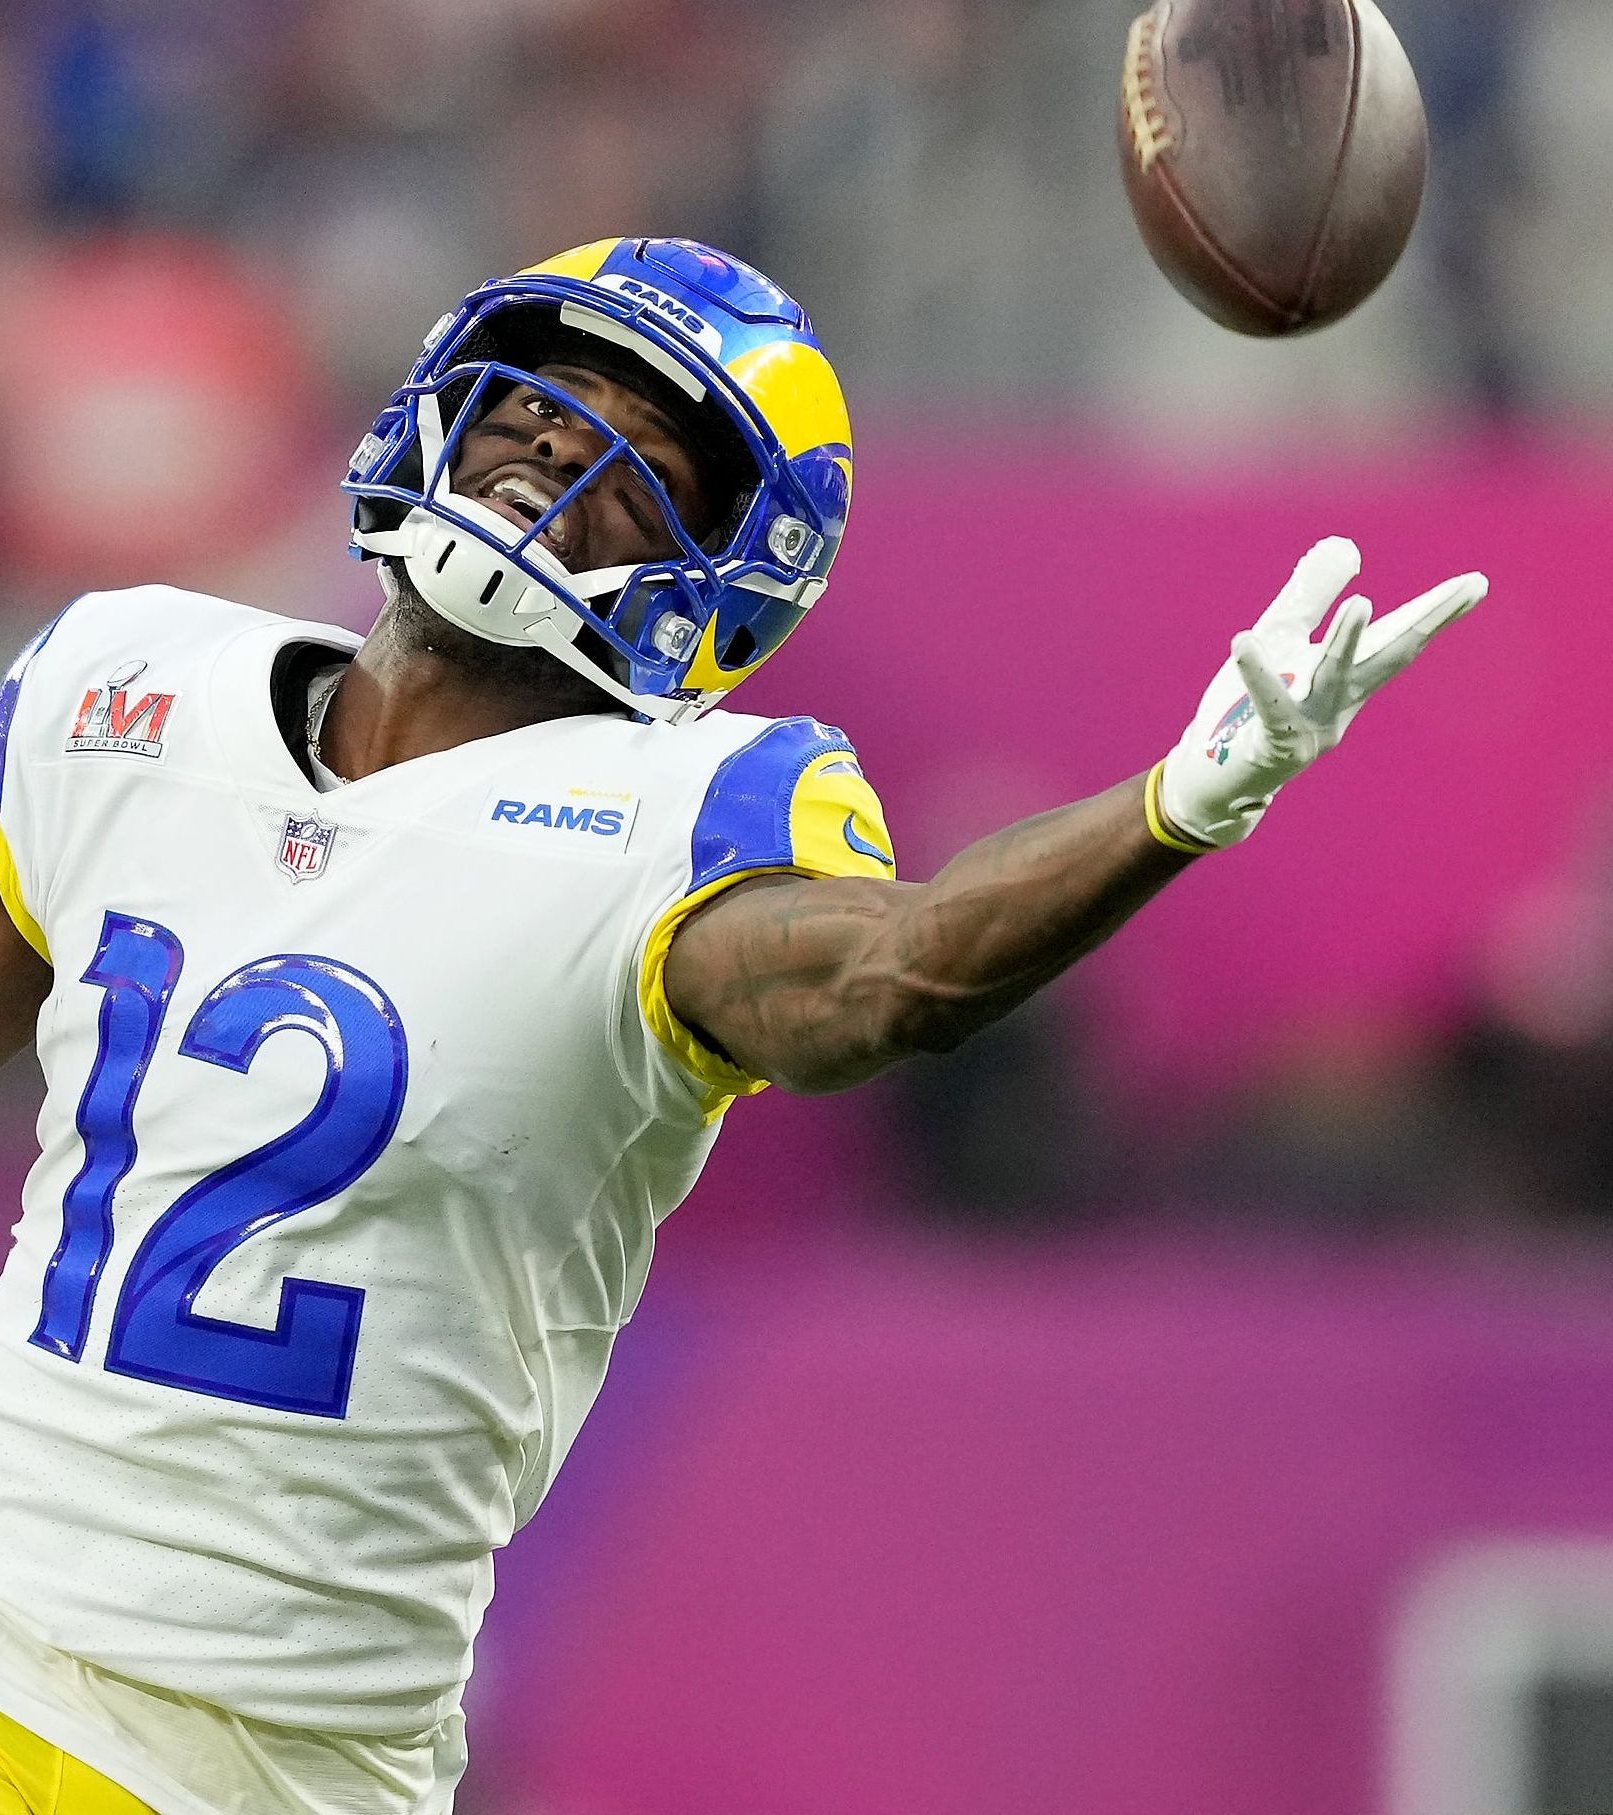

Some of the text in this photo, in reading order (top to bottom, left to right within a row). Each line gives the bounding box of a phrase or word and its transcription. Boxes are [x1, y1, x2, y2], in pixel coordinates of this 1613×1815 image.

[619, 280, 705, 334] RAMS
[72, 739, 149, 752] SUPER BOWL
[491, 799, 625, 836] RAMS
[282, 839, 318, 871] NFL
[27, 909, 409, 1420] 12
